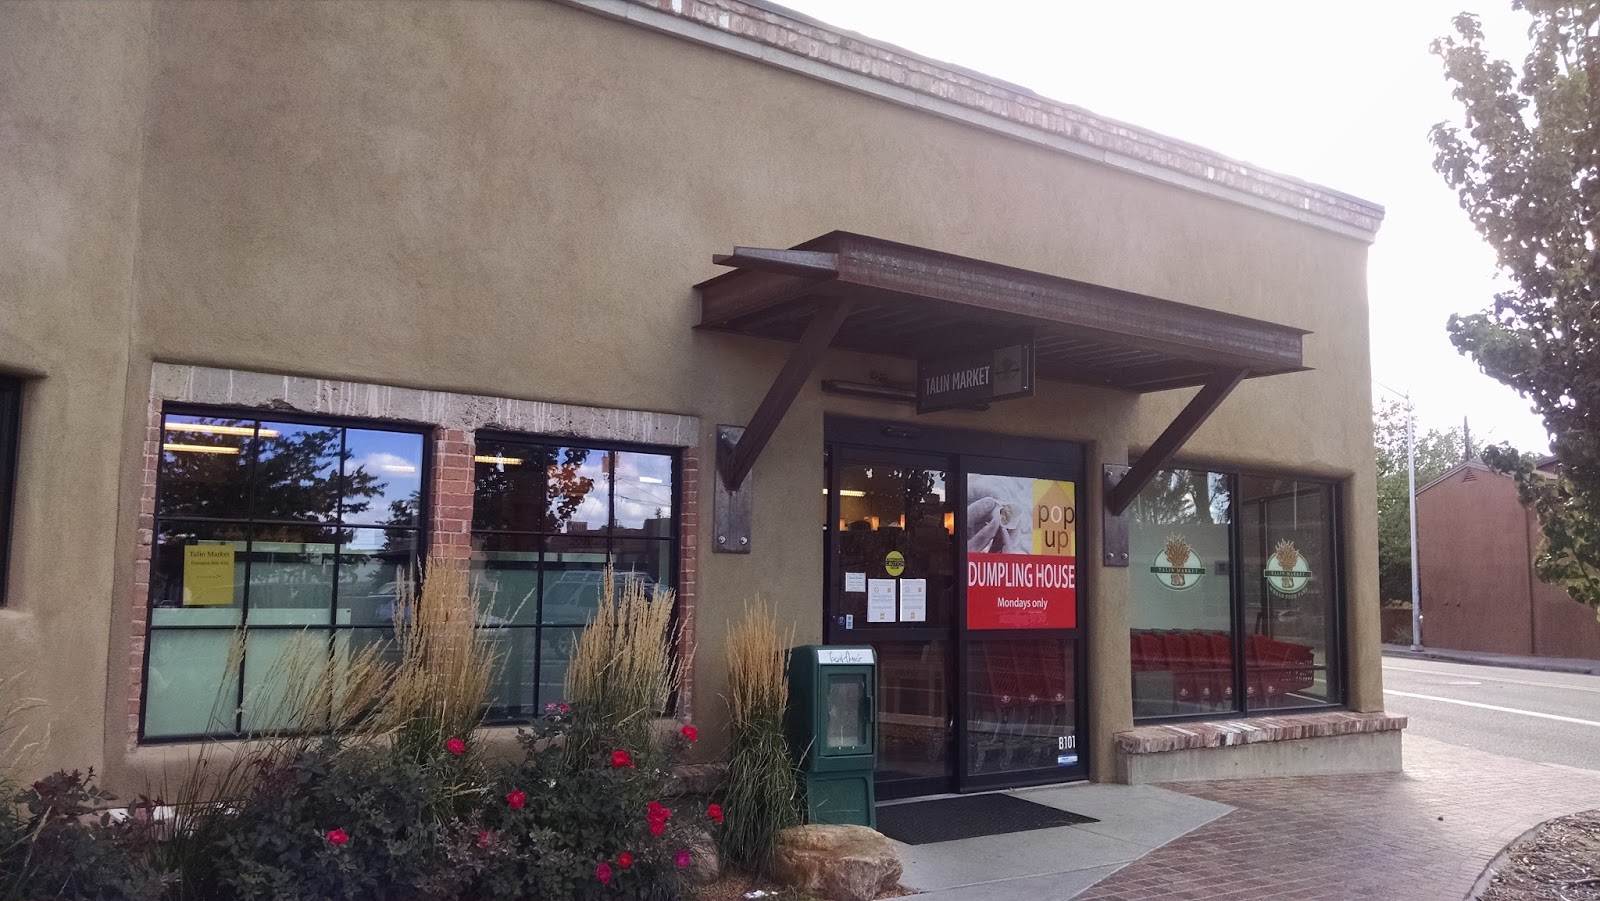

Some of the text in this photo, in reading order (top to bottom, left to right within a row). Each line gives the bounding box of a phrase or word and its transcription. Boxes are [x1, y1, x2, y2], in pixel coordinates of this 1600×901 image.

[926, 366, 990, 395] TALIN MARKET
[1038, 505, 1075, 529] pop
[1045, 530, 1069, 554] up
[968, 561, 1075, 589] DUMPLING HOUSE
[997, 597, 1048, 610] Mondays only
[1058, 735, 1076, 750] B101
